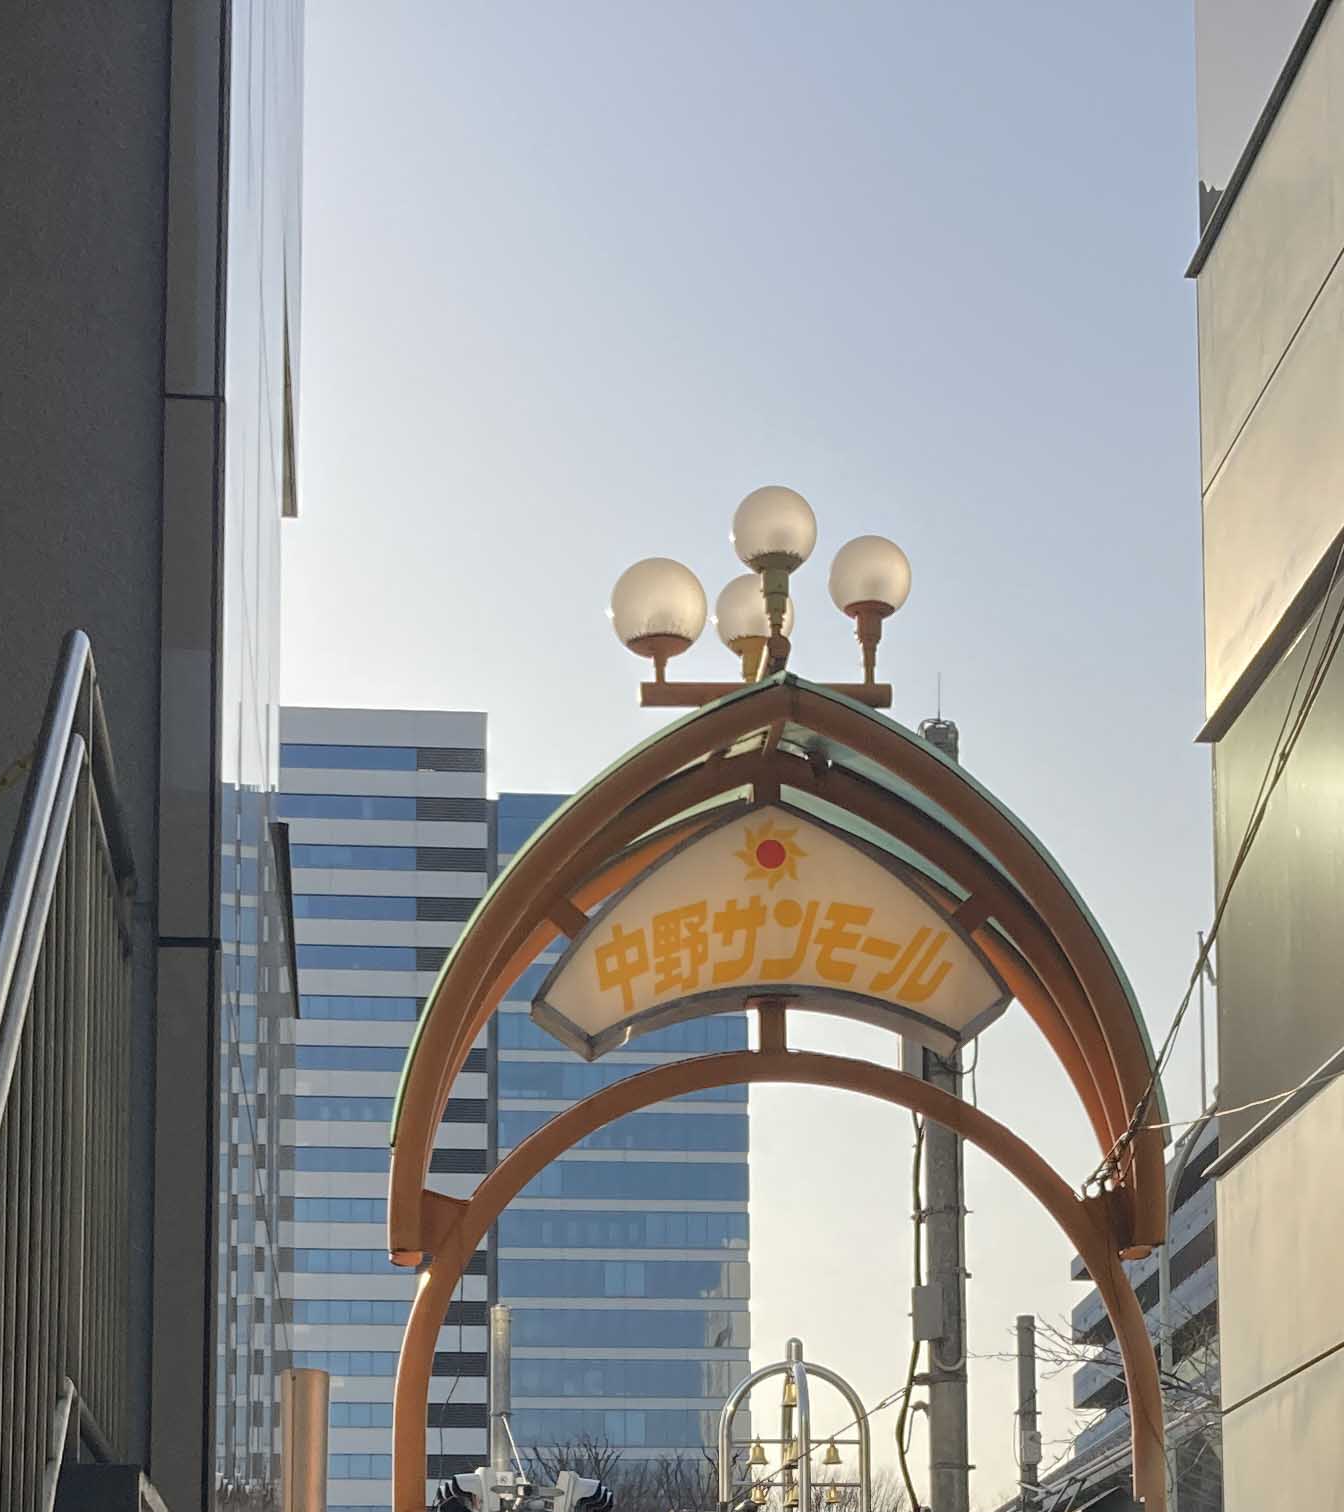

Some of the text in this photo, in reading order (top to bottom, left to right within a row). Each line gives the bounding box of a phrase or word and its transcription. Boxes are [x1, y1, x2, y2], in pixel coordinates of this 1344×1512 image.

[594, 895, 953, 1012] 中野サンモール
